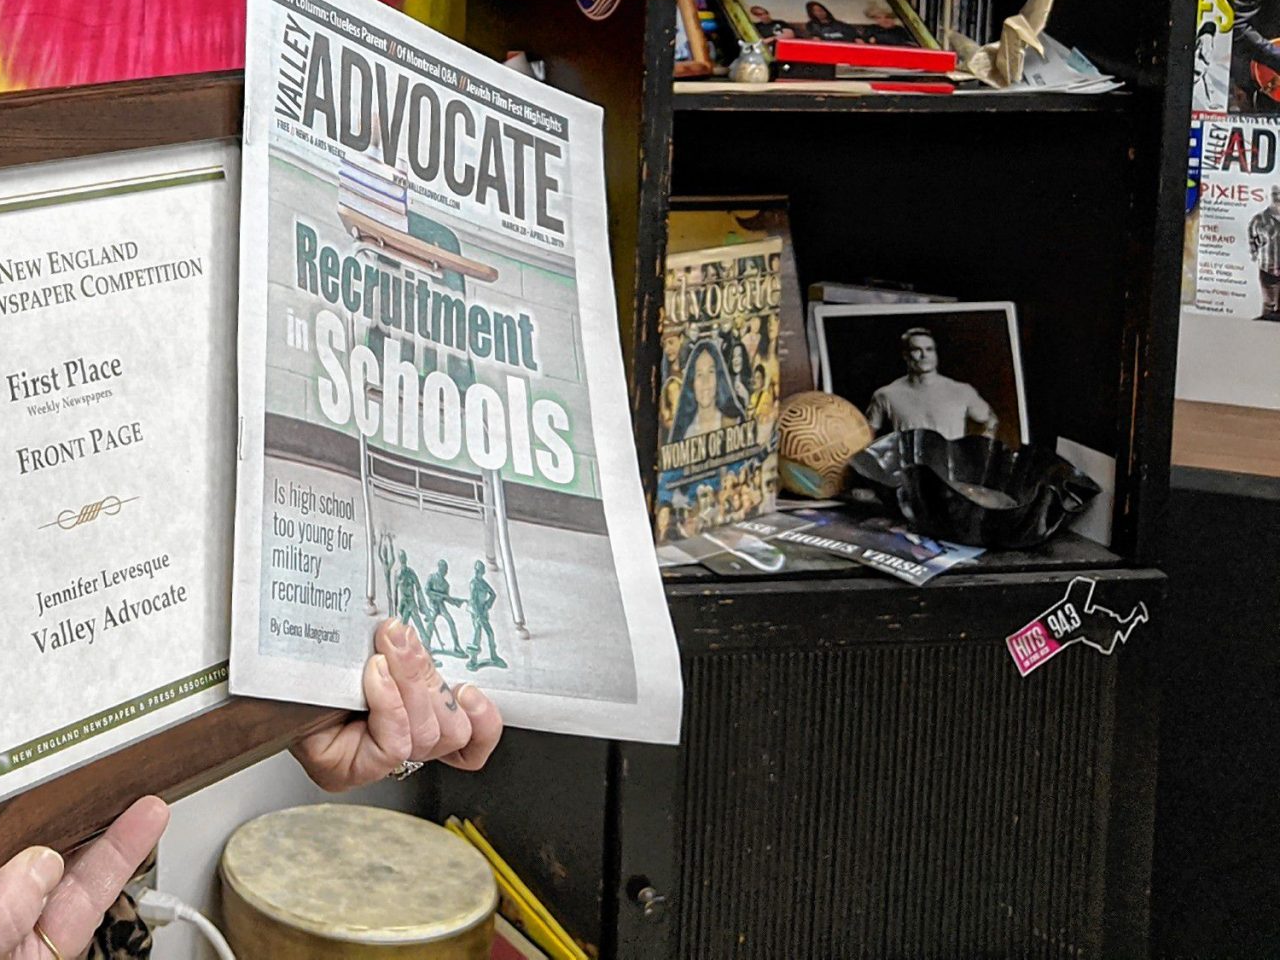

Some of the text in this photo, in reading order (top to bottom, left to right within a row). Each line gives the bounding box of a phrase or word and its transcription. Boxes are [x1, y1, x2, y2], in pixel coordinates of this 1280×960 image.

[330, 10, 361, 38] Clueless
[361, 26, 388, 52] Parent
[396, 45, 407, 60] Of
[406, 49, 441, 78] Montreal
[441, 67, 458, 87] Q&A
[466, 78, 492, 103] Jewish
[491, 90, 508, 110] Film
[507, 98, 524, 117] Fest
[523, 106, 563, 134] Highlights
[273, 13, 565, 235] VALLEY ADVOCATE
[276, 118, 290, 133] FREE
[295, 127, 310, 143] NEWS
[314, 138, 328, 152] ARTS
[327, 143, 347, 161] WEEKLY
[1201, 123, 1230, 171] VALLEY
[1199, 183, 1264, 202] PIXIES
[501, 219, 519, 234] MARCH
[529, 227, 546, 244] APRIL
[295, 220, 539, 371] Recruitment
[670, 274, 781, 324] dvocate
[285, 307, 310, 353] in
[6, 356, 124, 403] First Place
[314, 309, 576, 484] Schools
[26, 388, 113, 418] Weekly Newspapers
[661, 436, 707, 472] WOMEN
[708, 429, 724, 458] OF
[273, 478, 356, 522] Is high school
[273, 511, 354, 553] too young for
[776, 529, 861, 555] CHORUS
[862, 548, 929, 577] VERSE
[272, 544, 322, 579] military
[35, 553, 171, 618] Jennifer Levesque
[271, 578, 352, 613] recruitment?
[30, 584, 188, 654] Valley Advocate
[270, 617, 281, 637] By
[282, 618, 303, 639] Gena
[1011, 626, 1047, 662] HITS
[12, 748, 33, 766] NEW
[37, 729, 81, 754] ENGLAND
[83, 705, 137, 735] NEWSPAPER
[138, 701, 147, 712] &
[148, 687, 176, 708] PRESS
